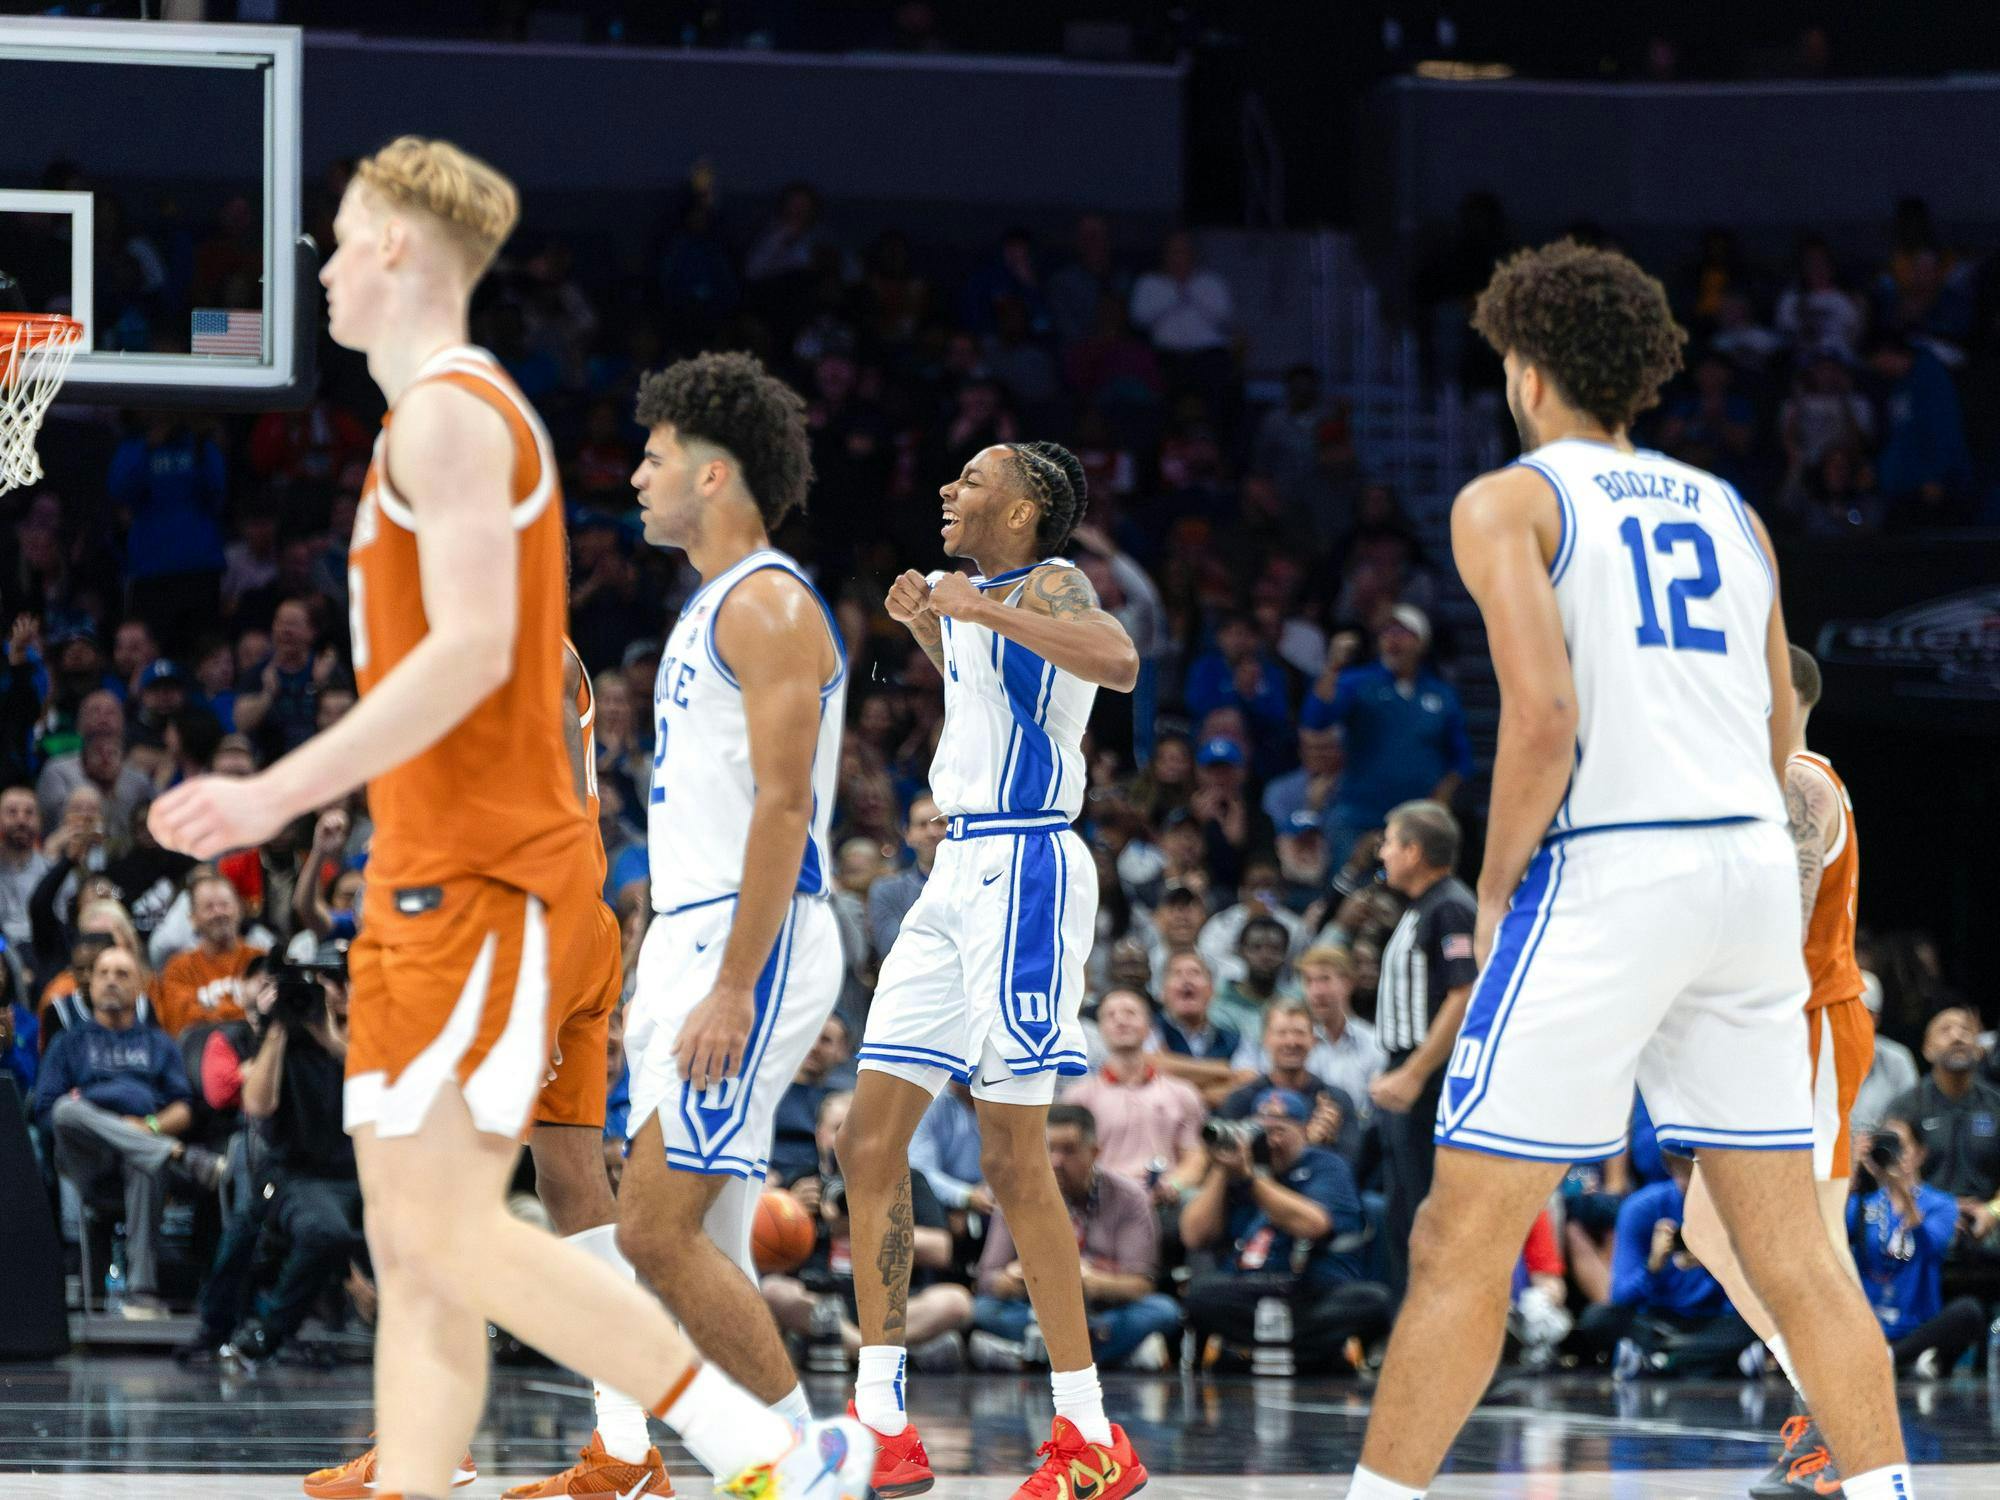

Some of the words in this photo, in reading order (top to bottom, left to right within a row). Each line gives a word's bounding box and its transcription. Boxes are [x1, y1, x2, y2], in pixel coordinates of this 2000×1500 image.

[1593, 471, 1701, 513] BOOZER
[1619, 516, 1727, 655] 12
[1015, 992, 1048, 1022] D
[1449, 1038, 1482, 1079] D
